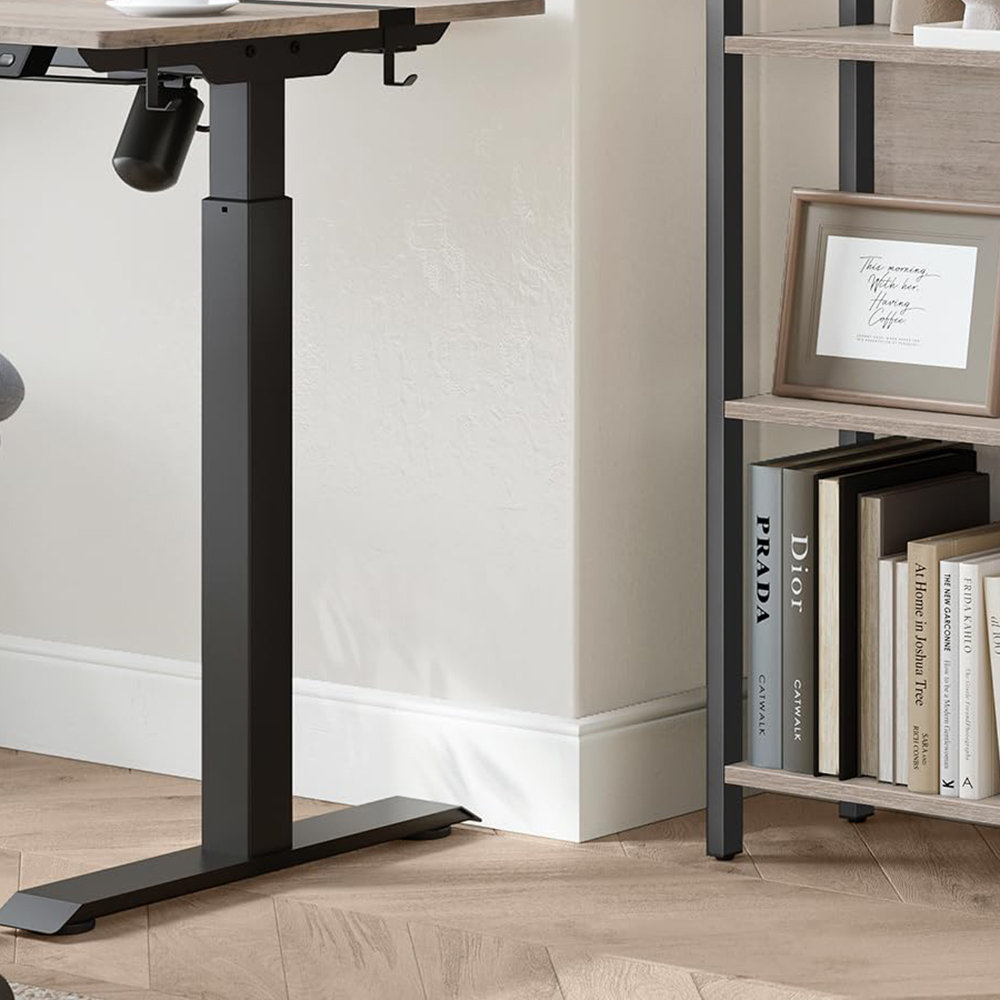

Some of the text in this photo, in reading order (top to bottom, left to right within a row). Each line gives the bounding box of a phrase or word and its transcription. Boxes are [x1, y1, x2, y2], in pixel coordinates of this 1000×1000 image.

[859, 255, 884, 273] This
[867, 271, 898, 293] With
[868, 307, 905, 329] Coffee
[869, 290, 926, 315] Having
[756, 515, 770, 624] PRADA
[791, 533, 808, 613] Dior
[915, 562, 927, 706] At Home in Joshua Tree
[963, 578, 972, 654] FRIDA KAHLO
[758, 674, 766, 736] CATWALK
[793, 679, 802, 741] CATWALK
[942, 779, 954, 788] K
[962, 777, 973, 789] A
